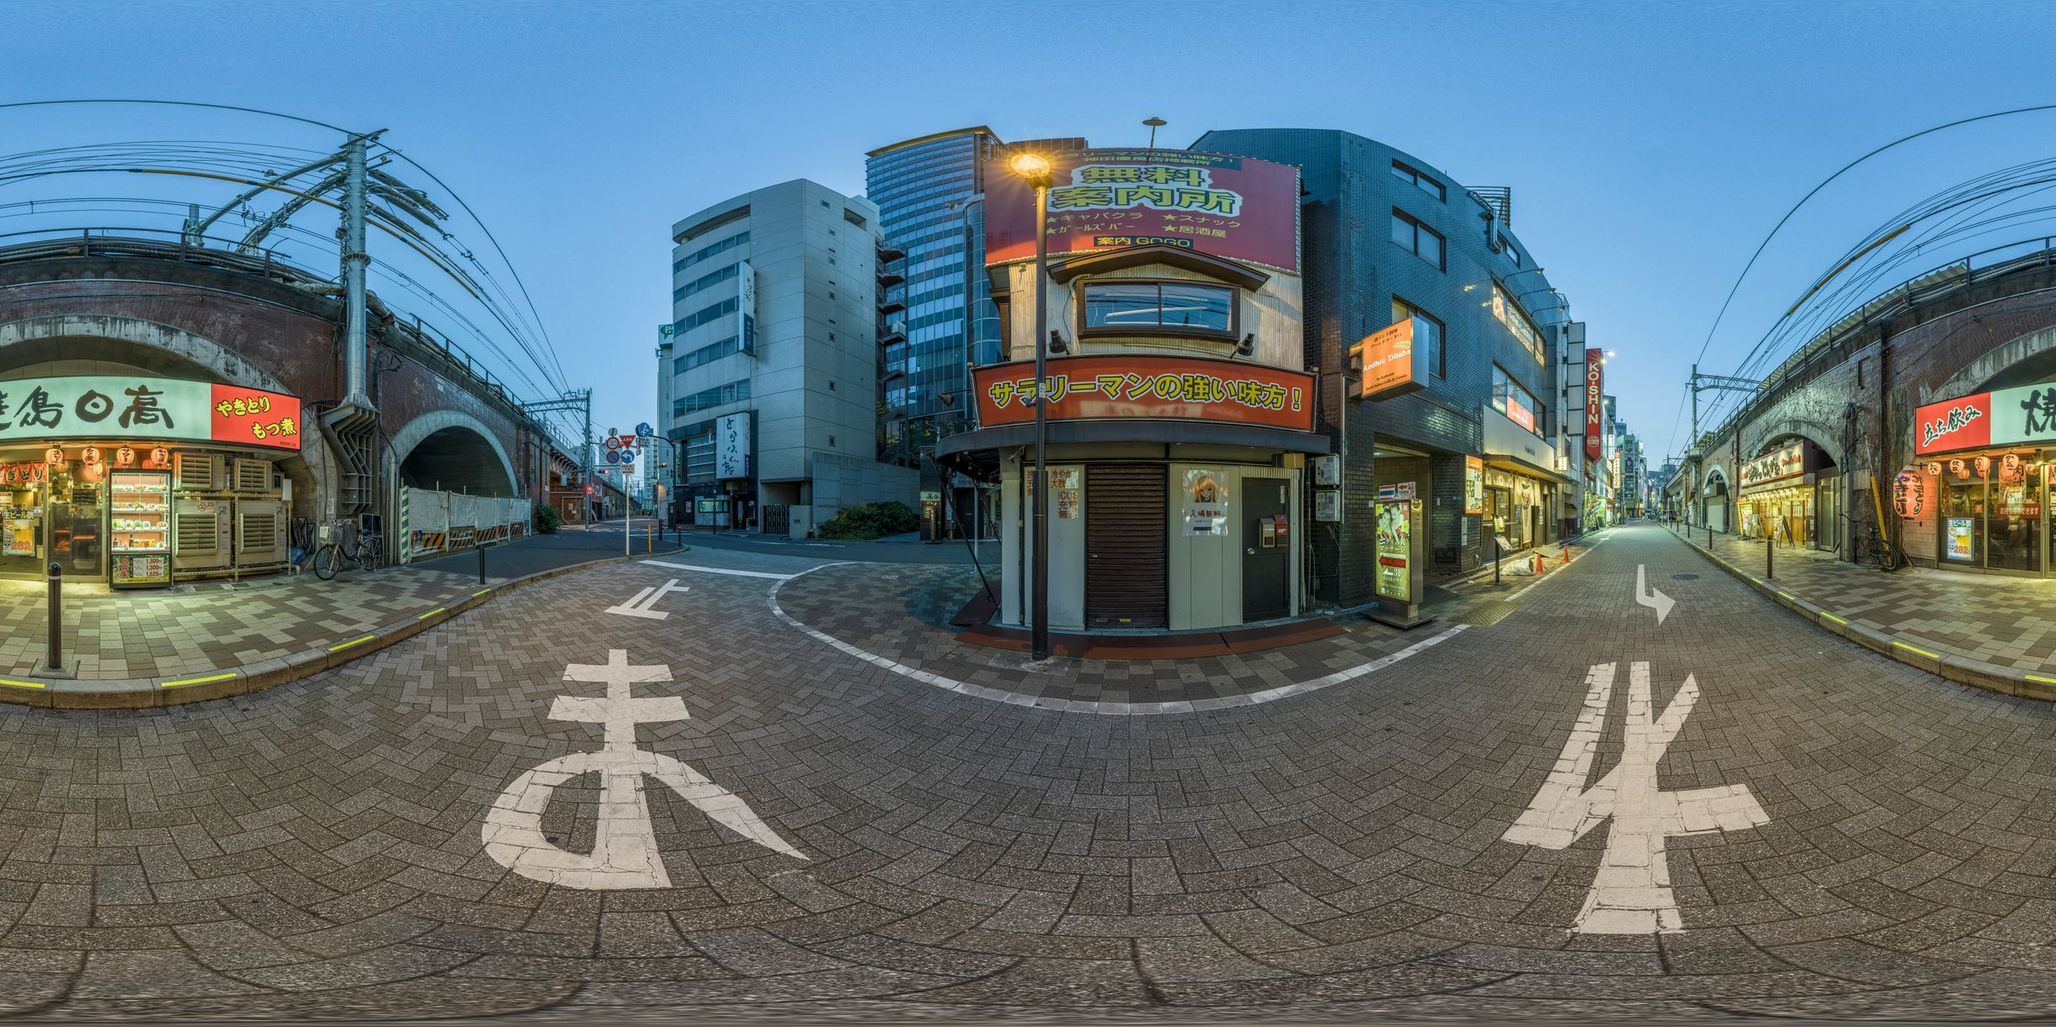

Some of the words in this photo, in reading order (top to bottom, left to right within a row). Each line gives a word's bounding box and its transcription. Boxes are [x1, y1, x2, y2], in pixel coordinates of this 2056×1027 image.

[1081, 166, 1208, 188] 無料
[1051, 186, 1236, 214] 案内所
[1061, 211, 1143, 222] キャバクラ
[1180, 214, 1241, 229] スナック
[1179, 225, 1227, 239] 居酒屋
[215, 395, 271, 418] やきとり
[252, 417, 297, 440] もつ煮
[1922, 405, 1982, 447] 立ち飲み
